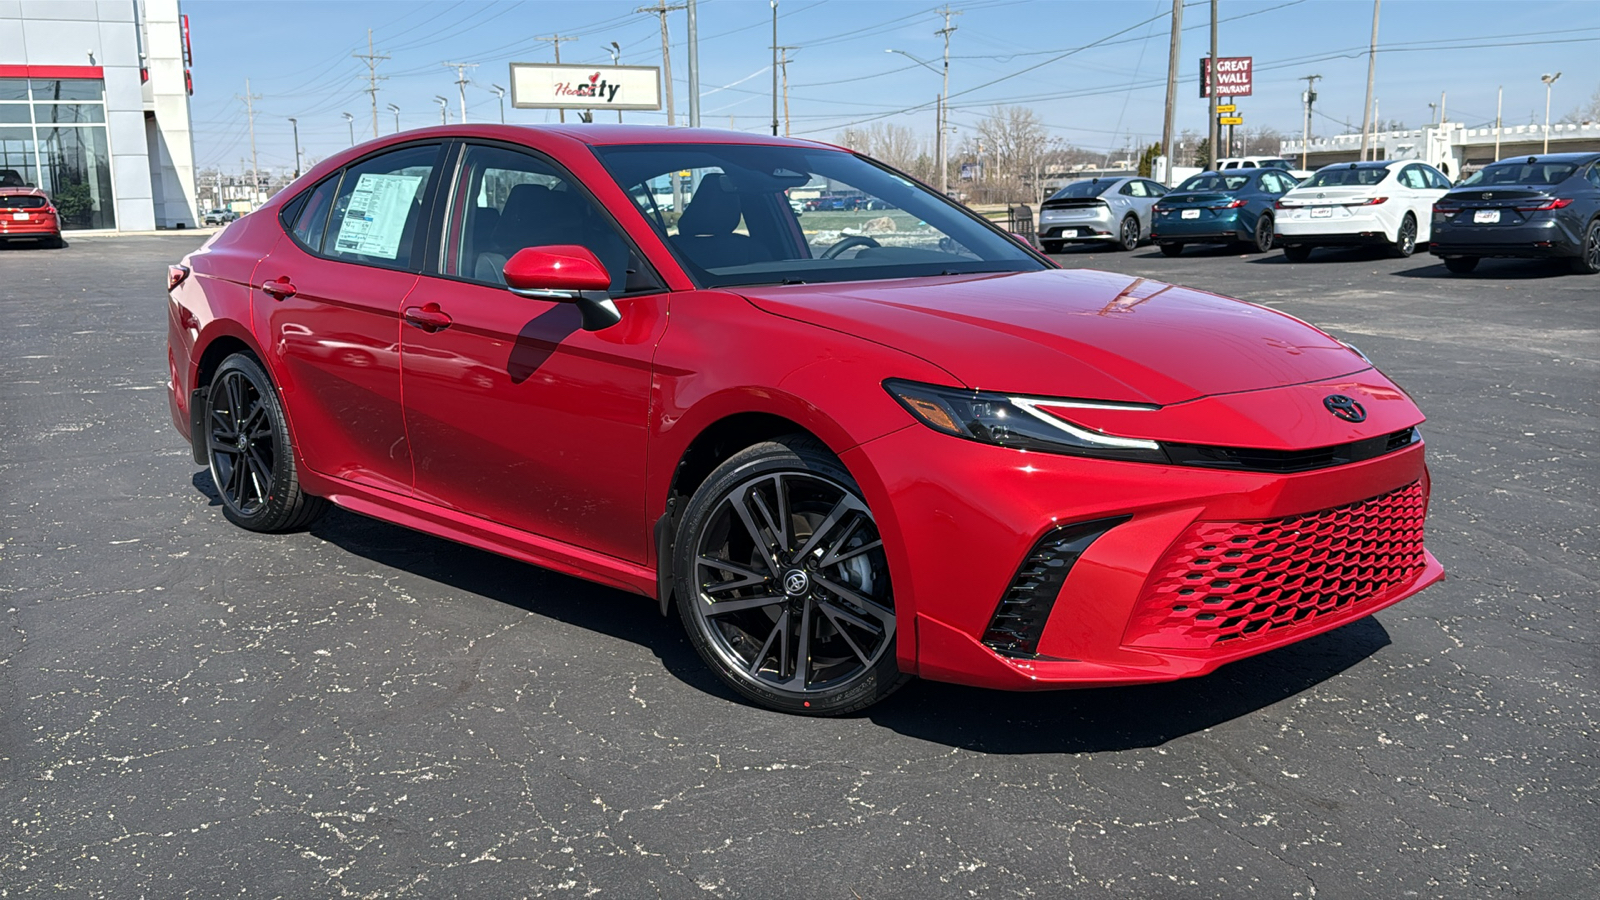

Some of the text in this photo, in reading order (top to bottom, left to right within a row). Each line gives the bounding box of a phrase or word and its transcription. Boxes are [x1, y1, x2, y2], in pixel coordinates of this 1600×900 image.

[1216, 60, 1250, 72] GREAT
[1217, 72, 1249, 84] WALL
[554, 82, 600, 96] Heart
[1205, 84, 1250, 94] RSTAURANT
